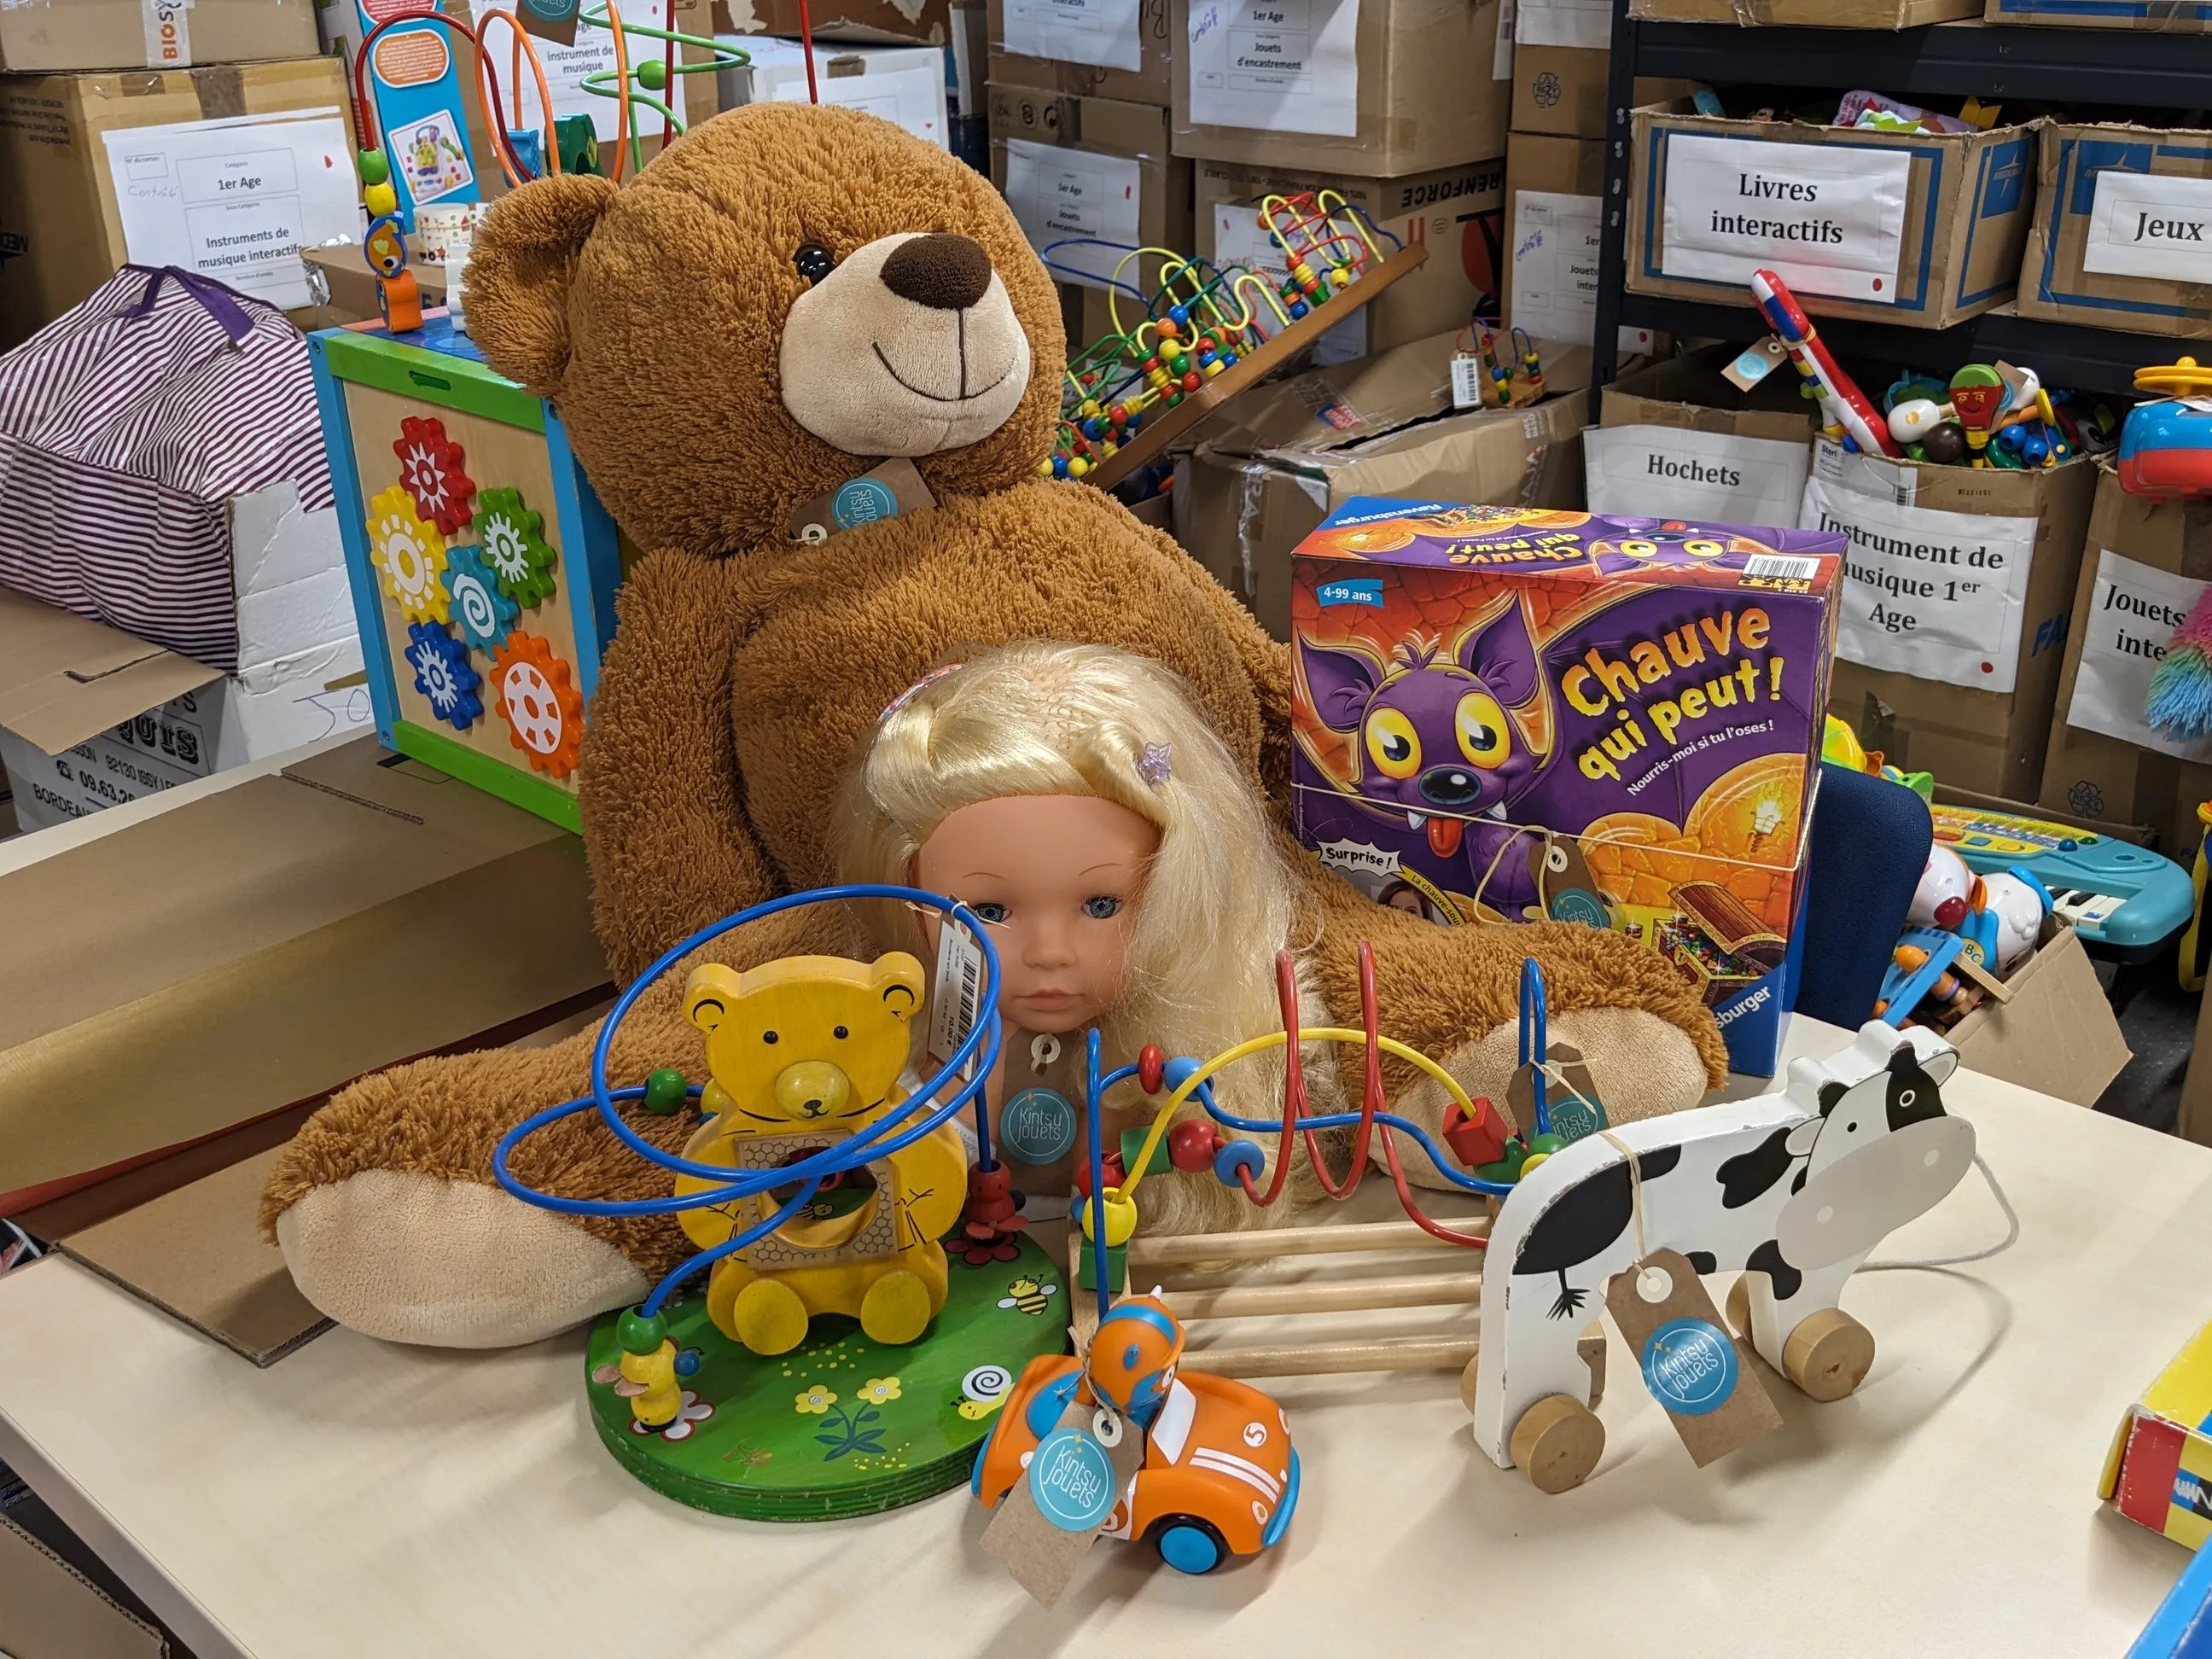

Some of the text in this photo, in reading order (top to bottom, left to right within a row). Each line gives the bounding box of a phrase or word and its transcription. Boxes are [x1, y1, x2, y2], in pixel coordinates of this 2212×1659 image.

[1253, 10, 1284, 24] 1er Age
[547, 44, 614, 62] instrument de
[1254, 43, 1282, 53] Jouets
[562, 61, 604, 74] musique
[218, 177, 262, 190] 1er Age
[1402, 172, 1501, 207] RENFORCE
[1738, 172, 1818, 203] Livres
[207, 227, 290, 248] Instruments de
[1710, 211, 1843, 245] interactifs
[2133, 211, 2205, 242] Jeux
[1585, 236, 1600, 246] 1er
[198, 250, 247, 269] musique
[1570, 265, 1598, 276] Jouets
[1647, 453, 1741, 487] Hochets
[860, 489, 877, 521] ouets
[1335, 504, 1442, 525] Ravensburger
[1535, 533, 1580, 548] qui
[1819, 512, 2004, 569] Instrument de
[1449, 545, 1583, 565] Chauve
[1324, 586, 1372, 602] 4-99 ans
[1943, 577, 1981, 602] 1er
[2104, 584, 2186, 627] Jouets
[1869, 602, 1917, 633] Age
[1561, 607, 1771, 717] Chauve
[1579, 708, 1647, 781] qui
[1626, 741, 1701, 796] Nourris-moi
[1698, 735, 1709, 750] si
[1709, 731, 1726, 746] tu
[1411, 874, 1421, 885] La
[1962, 944, 1982, 963] BC
[1715, 986, 1771, 1029] sburger
[1019, 1108, 1062, 1126] Kintsu
[1016, 1124, 1062, 1143] jouets
[1659, 1339, 1709, 1378] Kintsu
[1671, 1353, 1719, 1399] jouets
[1246, 1425, 1265, 1444] 5
[1055, 1445, 1102, 1493] Kintsu
[1043, 1464, 1095, 1508] jouets
